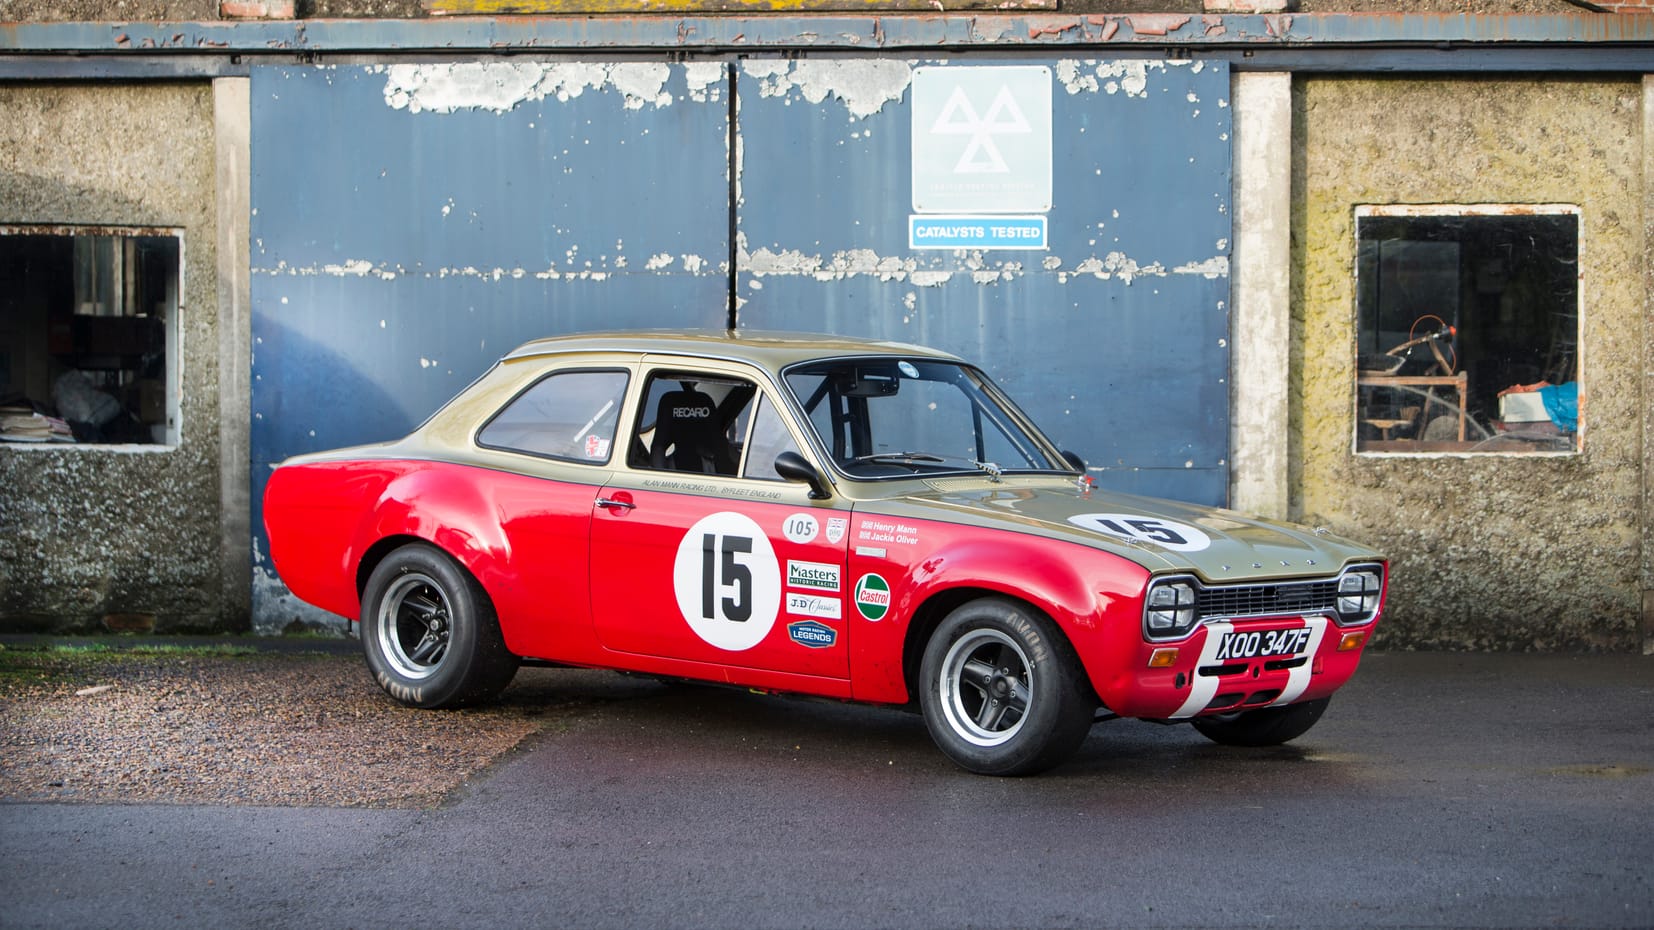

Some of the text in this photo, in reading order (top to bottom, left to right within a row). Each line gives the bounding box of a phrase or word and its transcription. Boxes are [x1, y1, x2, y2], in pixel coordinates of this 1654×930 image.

[916, 226, 1041, 238] CATALYSTS TESTED
[673, 407, 710, 418] RECARO
[680, 483, 704, 491] RACING
[749, 489, 782, 499] ENGLAND
[789, 519, 813, 536] 105
[874, 522, 918, 534] Henry Mann
[1096, 519, 1188, 545] 15
[871, 532, 919, 545] Jackie Oliver
[702, 533, 753, 622] 15
[790, 563, 838, 582] Masters
[790, 578, 815, 586] HISTORIC
[860, 590, 889, 605] Castrol
[793, 630, 832, 642] LEGENDS
[1006, 612, 1048, 662] AVON
[1217, 628, 1312, 659] XOO 347F
